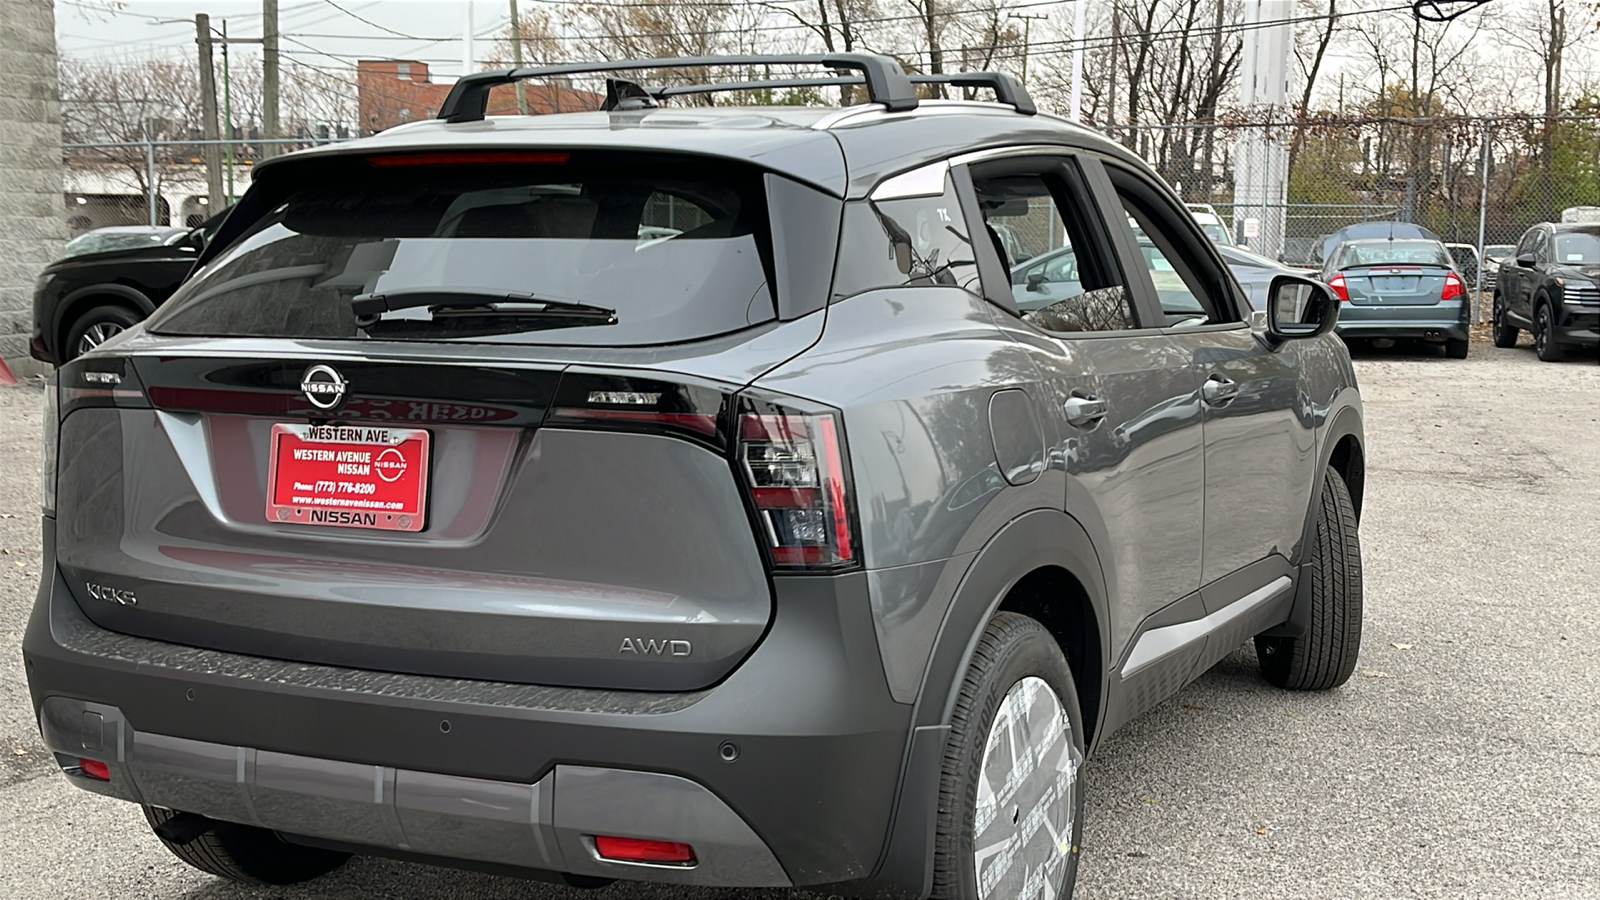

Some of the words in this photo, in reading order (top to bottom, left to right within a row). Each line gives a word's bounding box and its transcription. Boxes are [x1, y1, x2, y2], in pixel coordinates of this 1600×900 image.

[301, 383, 346, 393] NISSAN
[309, 427, 363, 442] WESTERN
[293, 448, 335, 461] WESTERN
[336, 451, 371, 463] AVENUE
[337, 463, 370, 475] NISSAN
[374, 461, 407, 469] NISSAN
[315, 481, 336, 495] (773)
[337, 482, 376, 494] 776-8200
[292, 496, 404, 510] www.westernavenissan.com
[311, 510, 377, 526] NISSAN
[86, 582, 138, 606] KICKS
[618, 637, 692, 656] AWD
